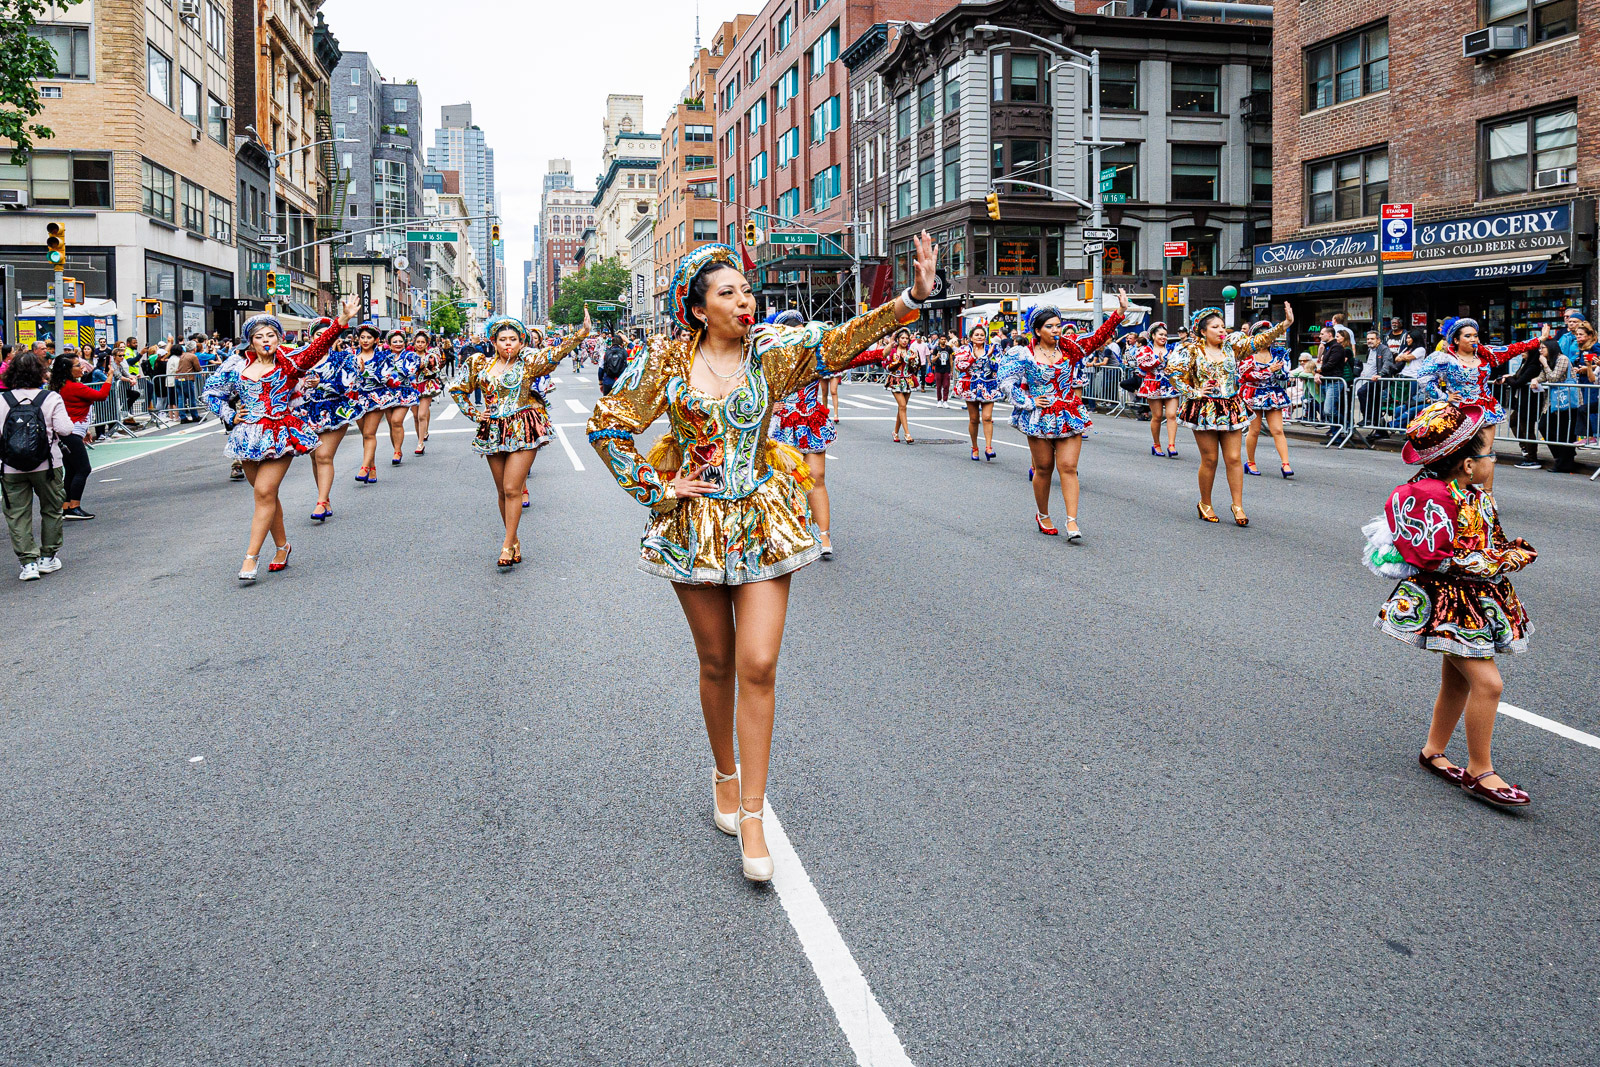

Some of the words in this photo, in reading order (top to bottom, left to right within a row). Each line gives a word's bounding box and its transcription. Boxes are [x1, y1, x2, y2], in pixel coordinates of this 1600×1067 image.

[1111, 194, 1118, 202] 16
[1421, 226, 1438, 244] &
[1440, 210, 1558, 243] GROCERY
[1262, 244, 1305, 264] Blue
[1310, 236, 1366, 257] Valley
[1452, 242, 1482, 254] COLD
[1486, 239, 1516, 252] BEER
[1518, 238, 1528, 248] &
[1530, 234, 1564, 248] SODA
[1256, 264, 1283, 274] BAGELS
[1288, 261, 1317, 272] COFFEE
[1322, 258, 1346, 268] FRUIT
[1348, 254, 1376, 266] SALAD
[1474, 263, 1532, 277] 212)242-9119
[810, 276, 836, 286] LIQUOR
